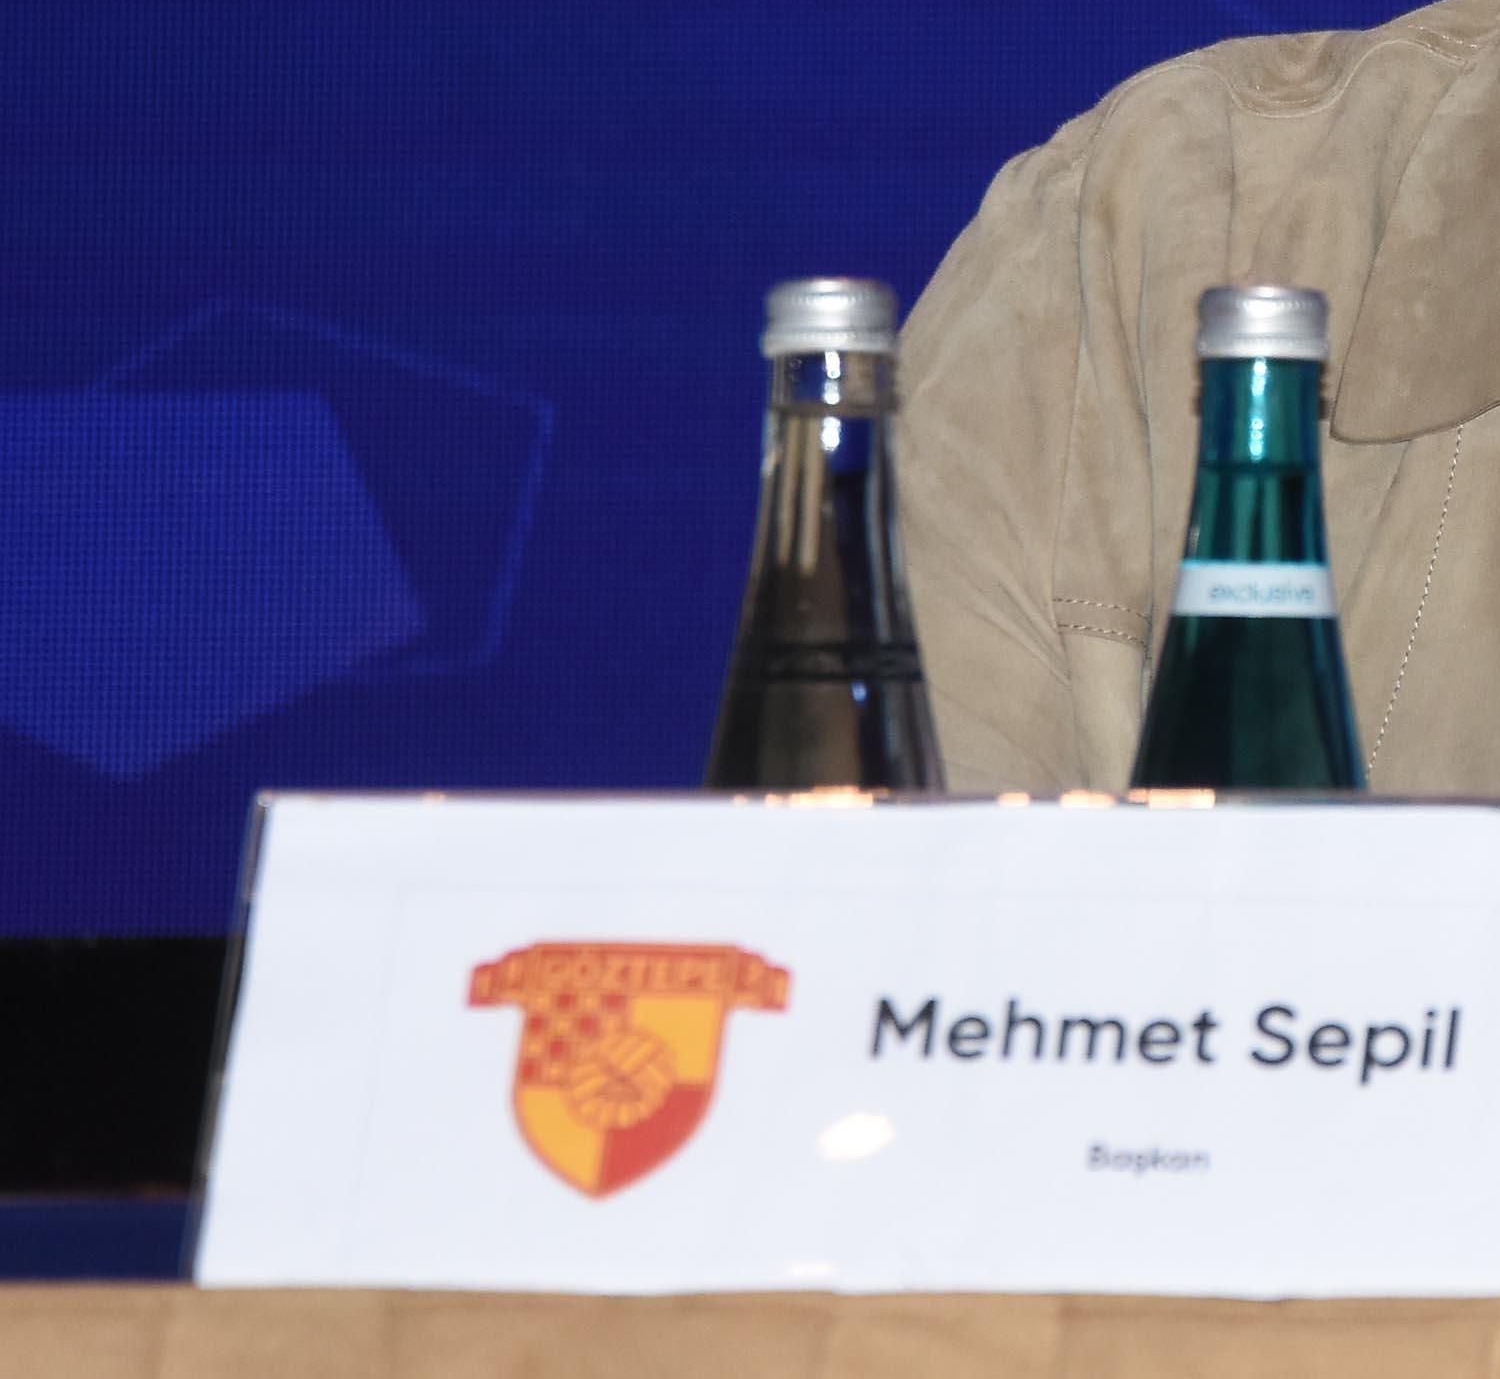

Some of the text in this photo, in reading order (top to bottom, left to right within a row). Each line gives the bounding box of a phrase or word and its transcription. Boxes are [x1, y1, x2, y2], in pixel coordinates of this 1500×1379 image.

[1209, 580, 1314, 602] exclusive
[869, 996, 1461, 1087] Mehmet Sepil
